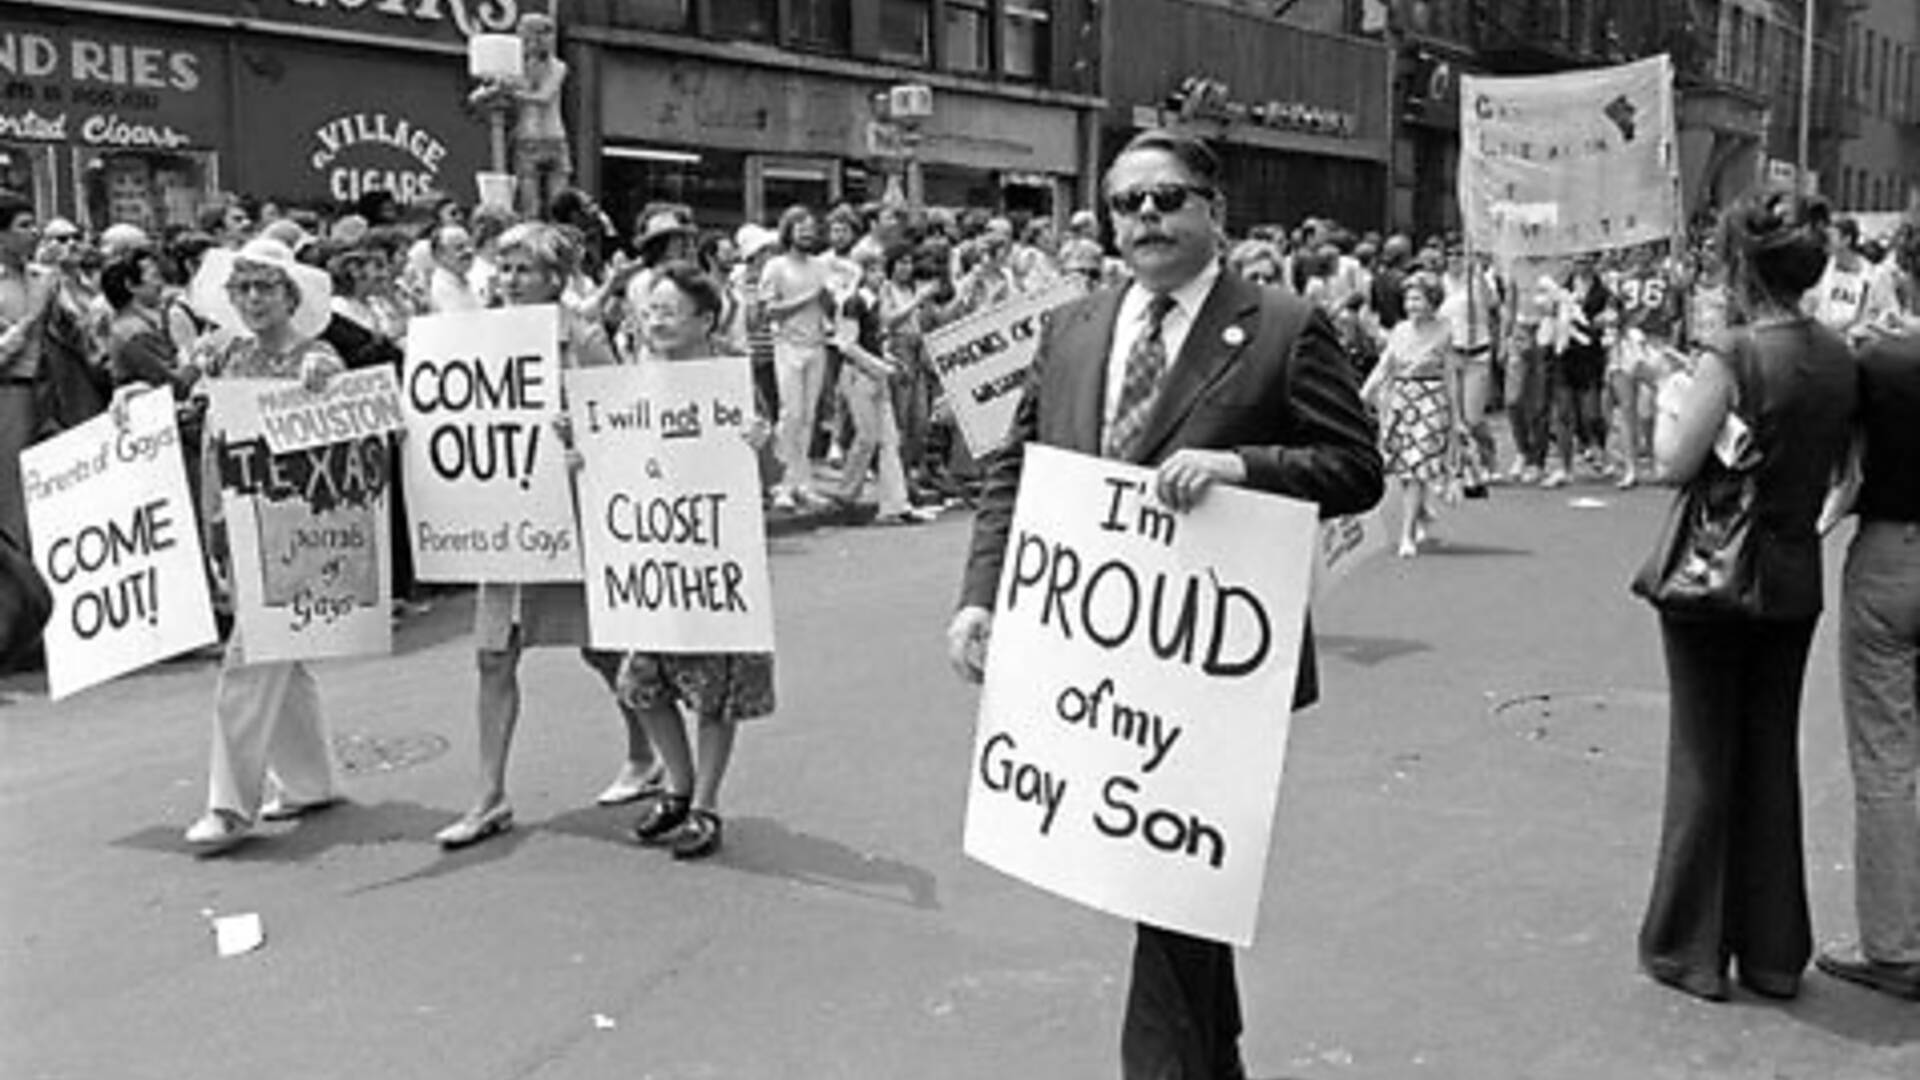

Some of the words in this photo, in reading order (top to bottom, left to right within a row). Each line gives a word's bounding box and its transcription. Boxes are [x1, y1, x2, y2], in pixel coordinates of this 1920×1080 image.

[314, 114, 447, 172] VILLAGE
[331, 167, 433, 204] CIGARS
[409, 355, 546, 414] COME
[264, 391, 404, 450] HOUSTON
[586, 400, 600, 434] I
[608, 399, 652, 430] will
[661, 403, 701, 431] not
[713, 399, 743, 427] be
[26, 459, 90, 502] Parents
[115, 425, 175, 463] Gays
[228, 438, 381, 500] TEXAS
[429, 422, 542, 490] OUT!
[644, 457, 663, 480] a
[46, 498, 179, 585] COME
[417, 520, 489, 553] Parents
[491, 522, 509, 553] of
[517, 520, 571, 560] Gays
[606, 493, 727, 549] CLOSET
[1099, 476, 1177, 547] I'm
[70, 566, 159, 640] OUT!
[604, 558, 748, 613] MOTHER
[1007, 529, 1272, 677] PROUD
[1055, 677, 1115, 729] of
[1111, 701, 1182, 774] my
[978, 731, 1067, 836] Gay
[1092, 775, 1226, 869] Son
